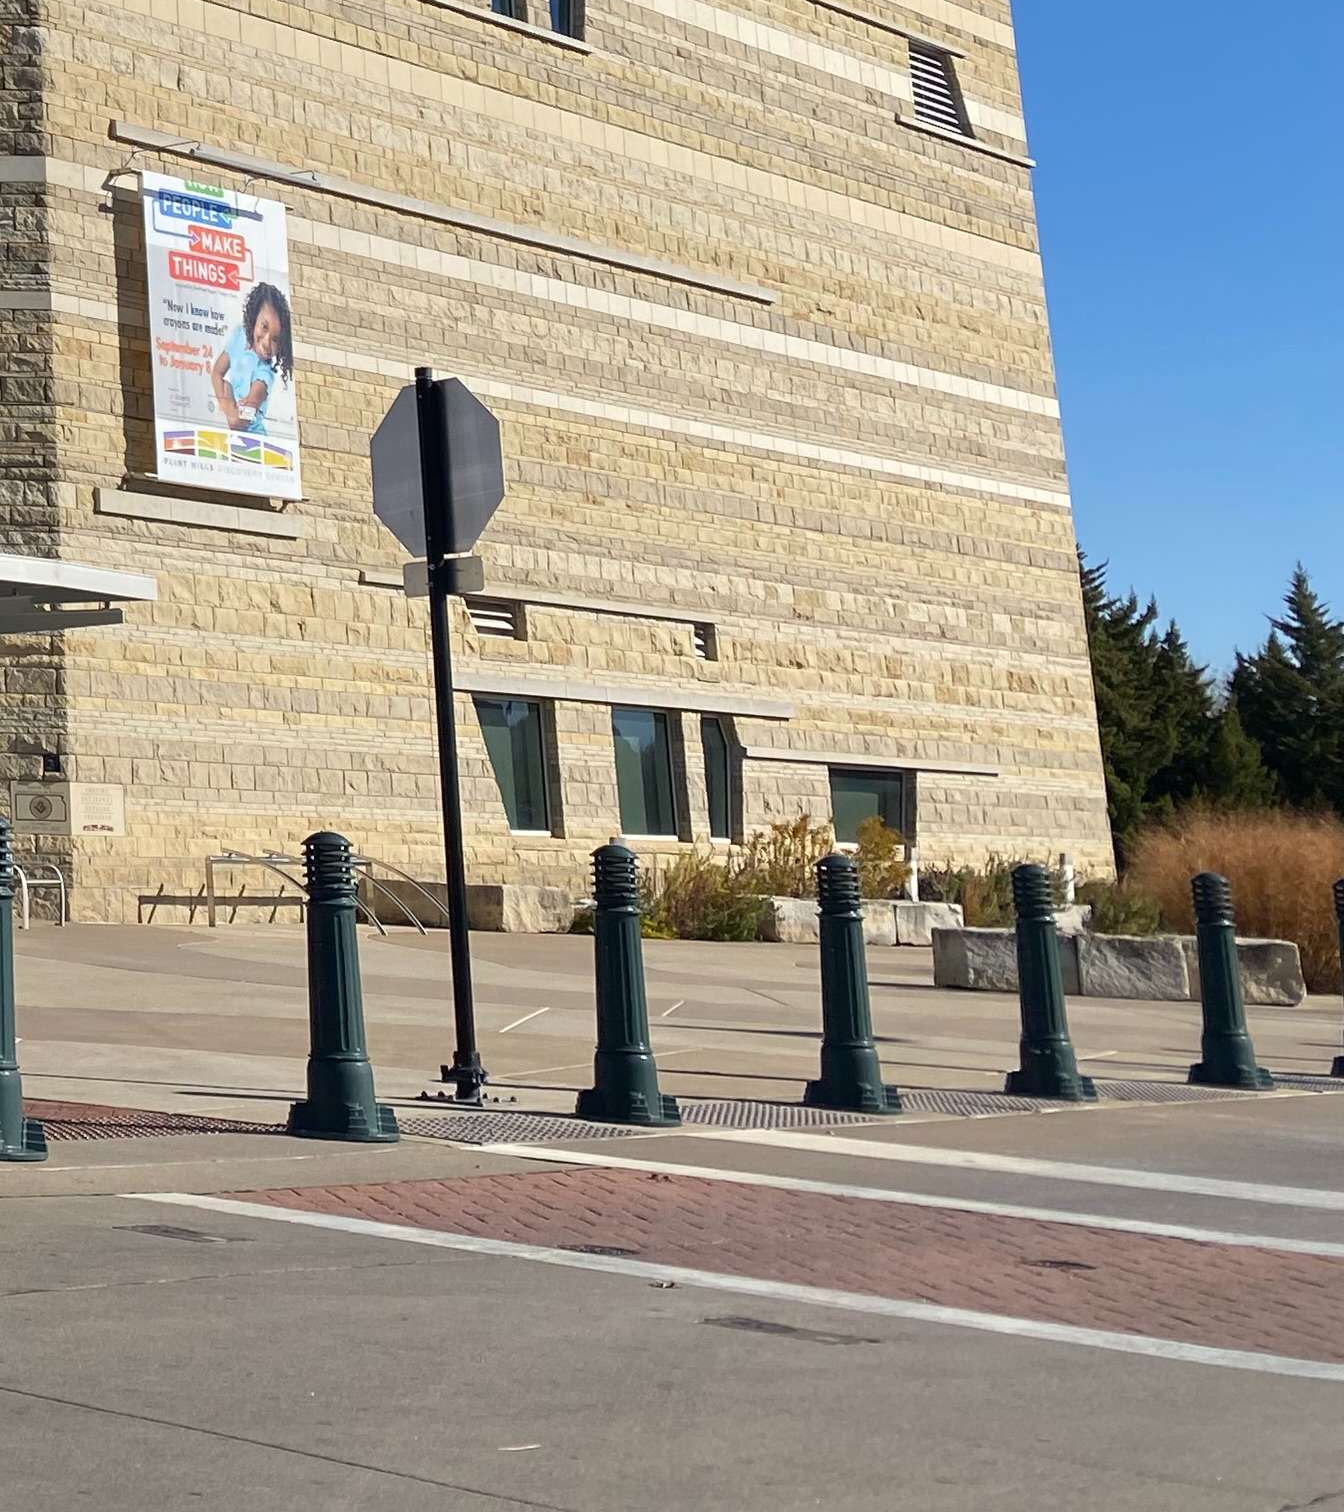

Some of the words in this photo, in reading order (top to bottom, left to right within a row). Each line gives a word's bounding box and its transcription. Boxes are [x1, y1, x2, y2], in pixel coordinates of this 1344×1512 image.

[163, 193, 218, 222] PEOPLE
[201, 232, 243, 257] MAKE
[173, 257, 226, 284] THINGS
[156, 337, 200, 356] September
[160, 354, 169, 367] to
[170, 355, 203, 376] January
